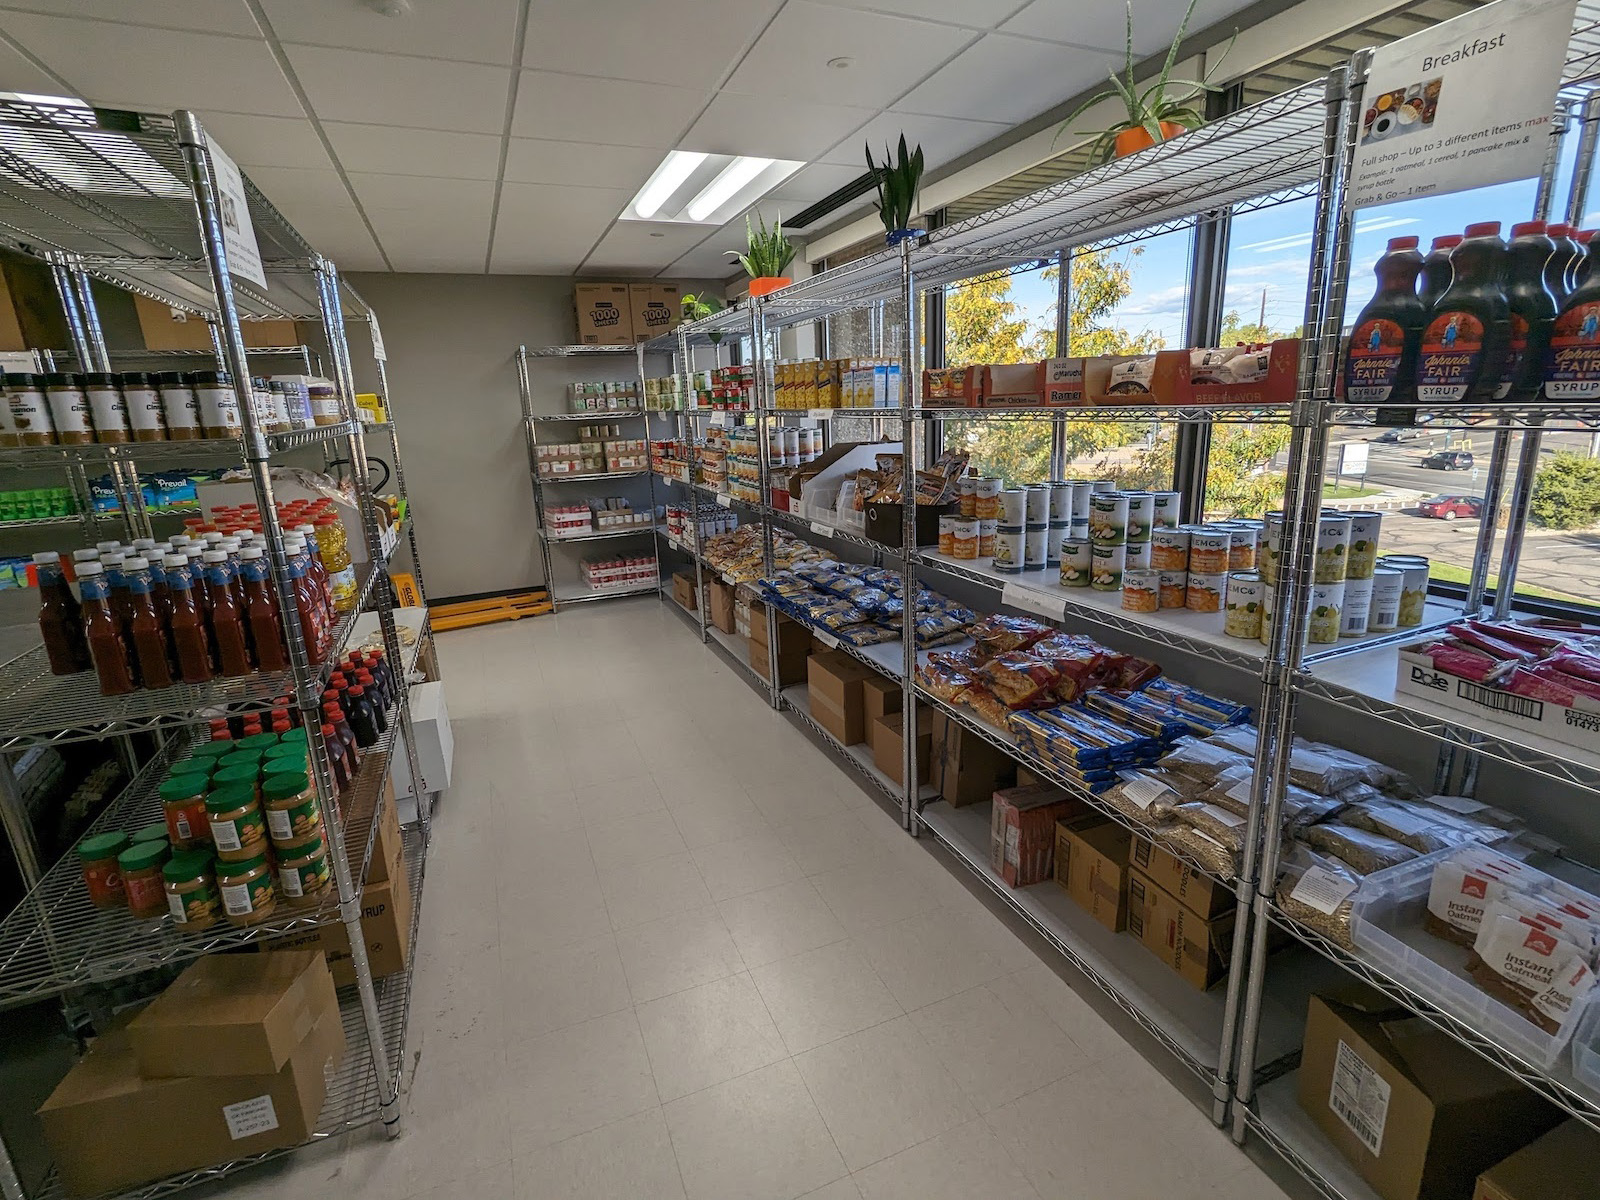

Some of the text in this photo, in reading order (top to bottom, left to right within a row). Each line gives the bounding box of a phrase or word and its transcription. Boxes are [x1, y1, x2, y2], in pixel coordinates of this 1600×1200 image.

[1422, 32, 1506, 72] Breakfast
[1361, 156, 1376, 167] Full
[1378, 152, 1398, 163] shop
[1408, 147, 1422, 156] Up
[1424, 144, 1434, 152] to
[1436, 140, 1442, 149] 3
[1444, 129, 1489, 147] different
[1491, 122, 1522, 135] items
[1524, 116, 1549, 127] max
[1359, 170, 1388, 181] Example:
[1467, 142, 1502, 157] pancake
[1504, 139, 1520, 148] mix
[1522, 135, 1530, 144] &
[1357, 178, 1395, 192] syrup bottle
[1355, 196, 1374, 206] Grab
[1376, 193, 1382, 202] &
[1386, 191, 1397, 200] Go
[1415, 184, 1436, 192] item
[590, 308, 619, 320] 1000
[643, 308, 670, 320] 1000
[1428, 366, 1461, 376] FAIR
[1560, 360, 1600, 371] FAIR
[1356, 368, 1386, 379] FAIR
[1423, 387, 1459, 395] SYRUP
[1553, 382, 1599, 392] SYRUP
[1196, 392, 1261, 403] BEEF FLAVOR
[158, 479, 187, 487] Prevail
[92, 486, 115, 495] Prev
[1411, 666, 1448, 688] Dole
[1566, 718, 1599, 732] 01473
[361, 904, 385, 919] YRUP
[1448, 901, 1484, 916] Instan
[1447, 910, 1482, 923] Oatme
[1506, 952, 1555, 976] Instant
[1504, 963, 1552, 984] Oatmeal
